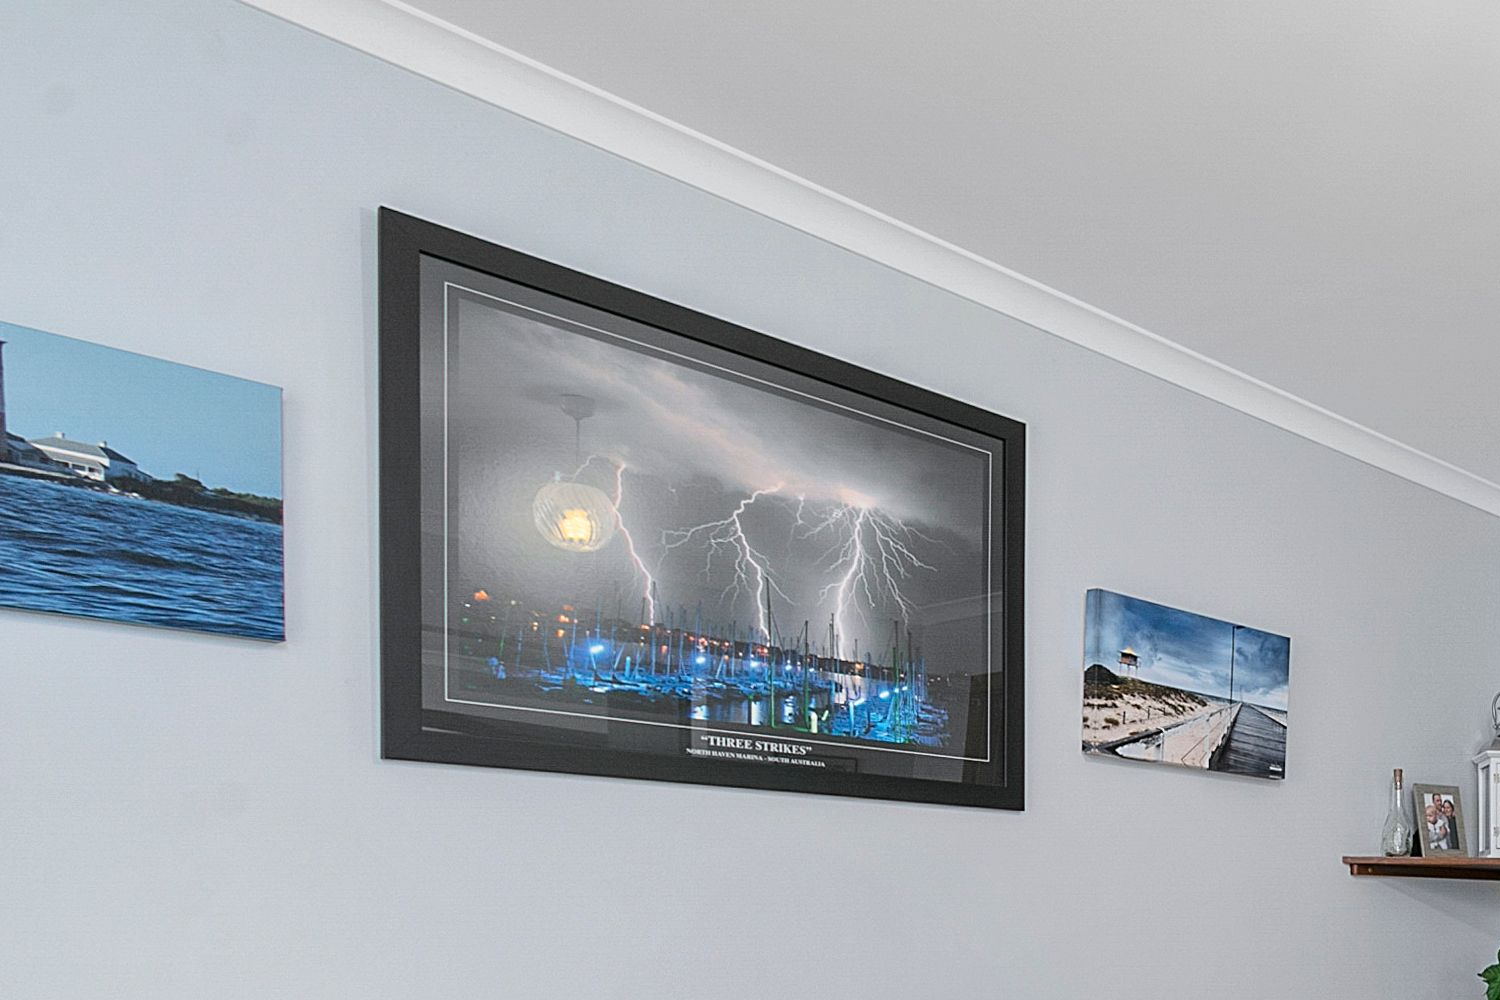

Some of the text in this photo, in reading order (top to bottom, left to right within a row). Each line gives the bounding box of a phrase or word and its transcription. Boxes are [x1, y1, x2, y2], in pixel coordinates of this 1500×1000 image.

[686, 747, 711, 756] NORTH
[711, 750, 736, 758] HAVEN
[736, 752, 763, 761] MARINA
[767, 756, 790, 764] SOUTH
[790, 758, 826, 767] AUSTRALIA
